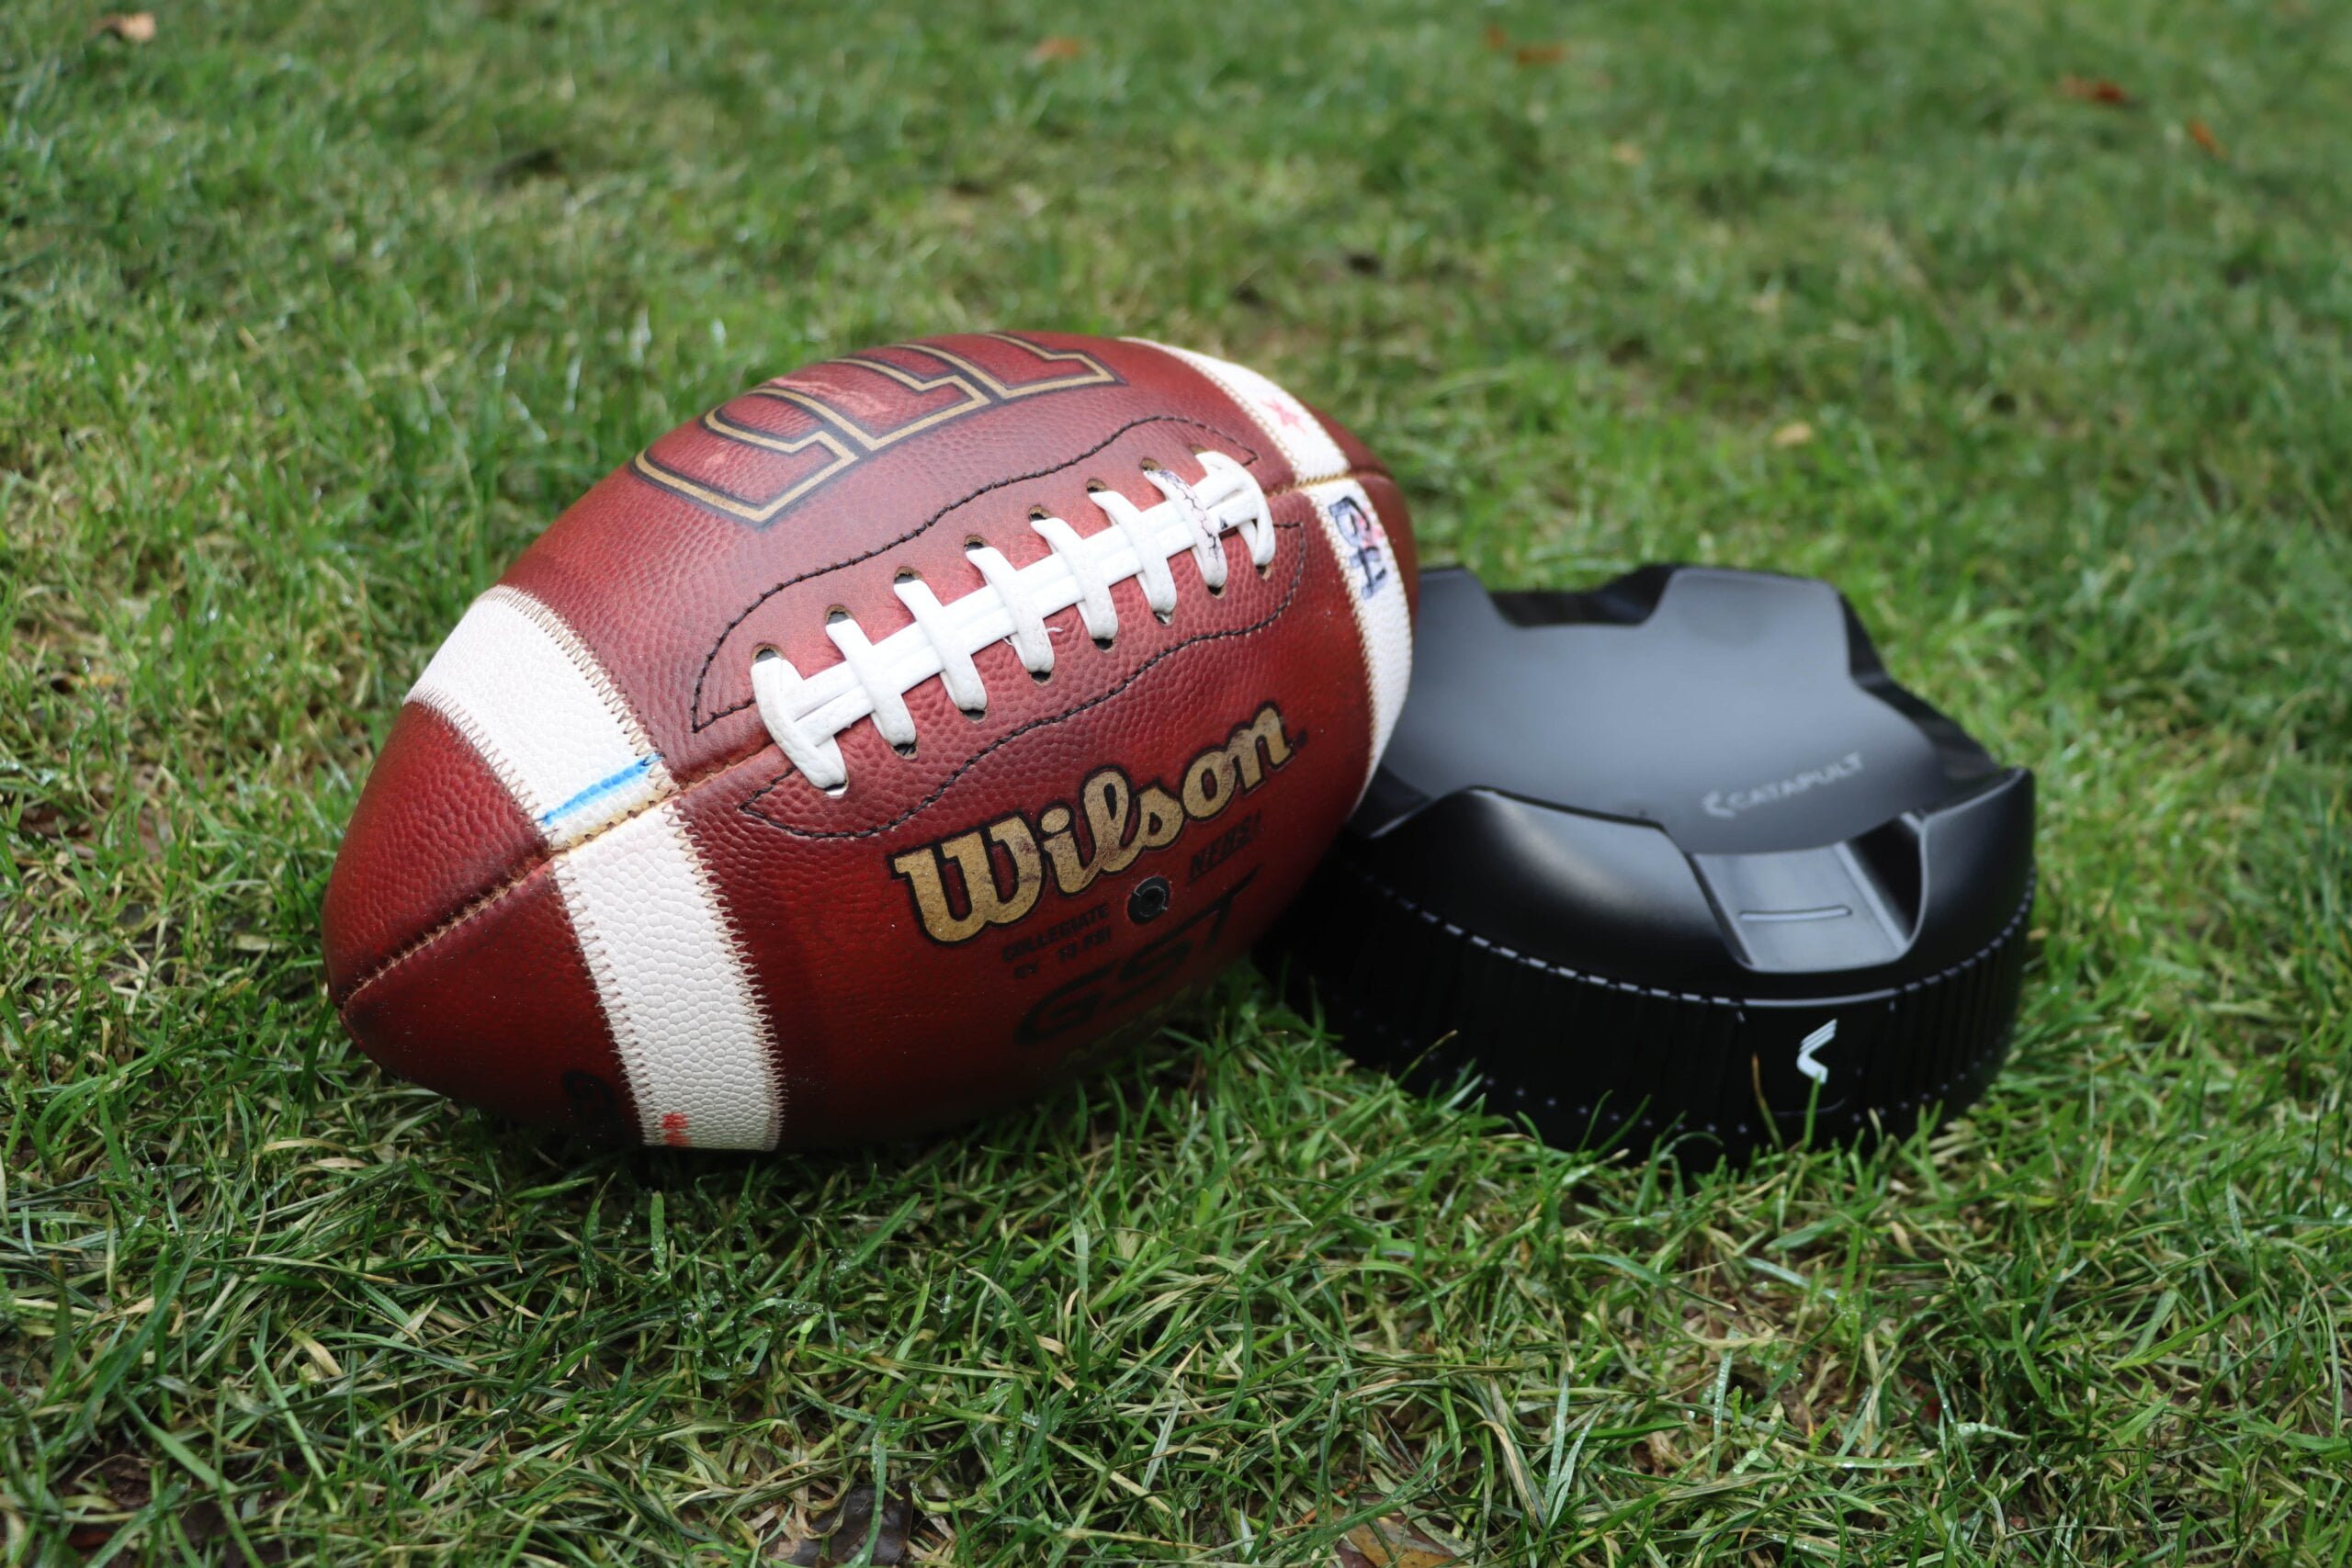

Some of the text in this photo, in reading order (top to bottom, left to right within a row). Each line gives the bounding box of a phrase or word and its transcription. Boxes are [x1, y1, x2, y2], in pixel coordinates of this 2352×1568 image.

[888, 700, 1295, 946] Wilson
[1727, 751, 1863, 810] CATAPULT
[1002, 903, 1109, 962] COLLEGIATE
[1014, 864, 1264, 1045] GST
